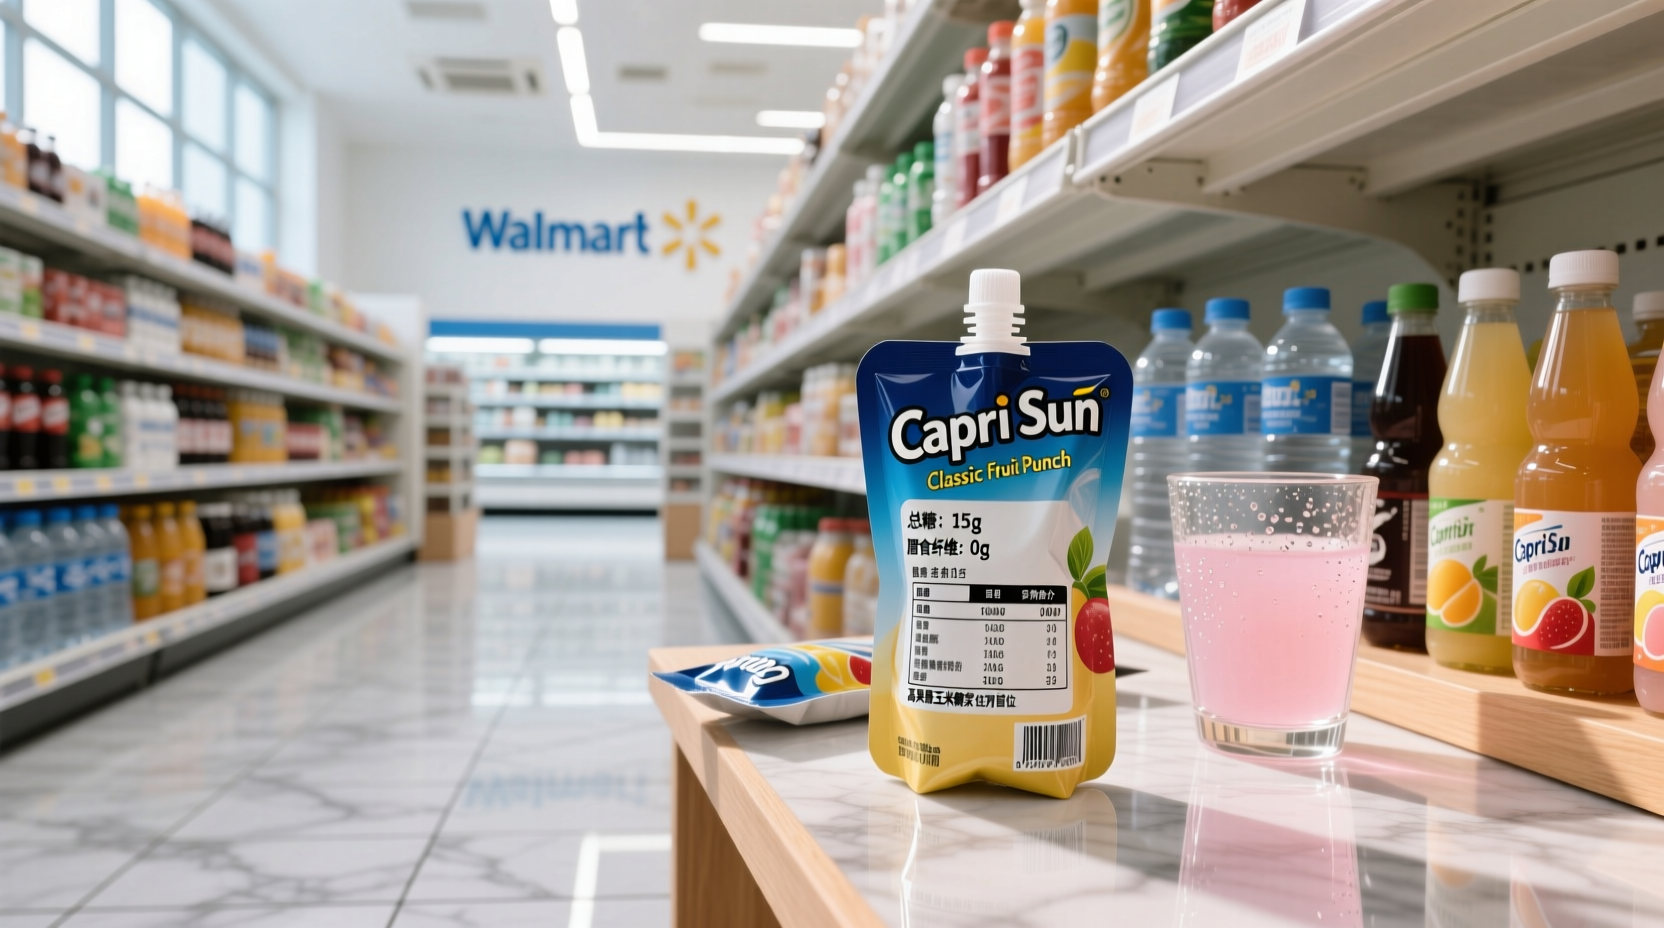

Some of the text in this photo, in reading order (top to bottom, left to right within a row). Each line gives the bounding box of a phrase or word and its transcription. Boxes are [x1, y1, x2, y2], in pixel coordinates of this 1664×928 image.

[462, 209, 651, 256] Walmart
[890, 386, 1100, 462] Capri Sun
[926, 466, 983, 491] Classic
[1022, 449, 1071, 475] Punch
[952, 512, 982, 535] 15g
[970, 539, 990, 561] 0g
